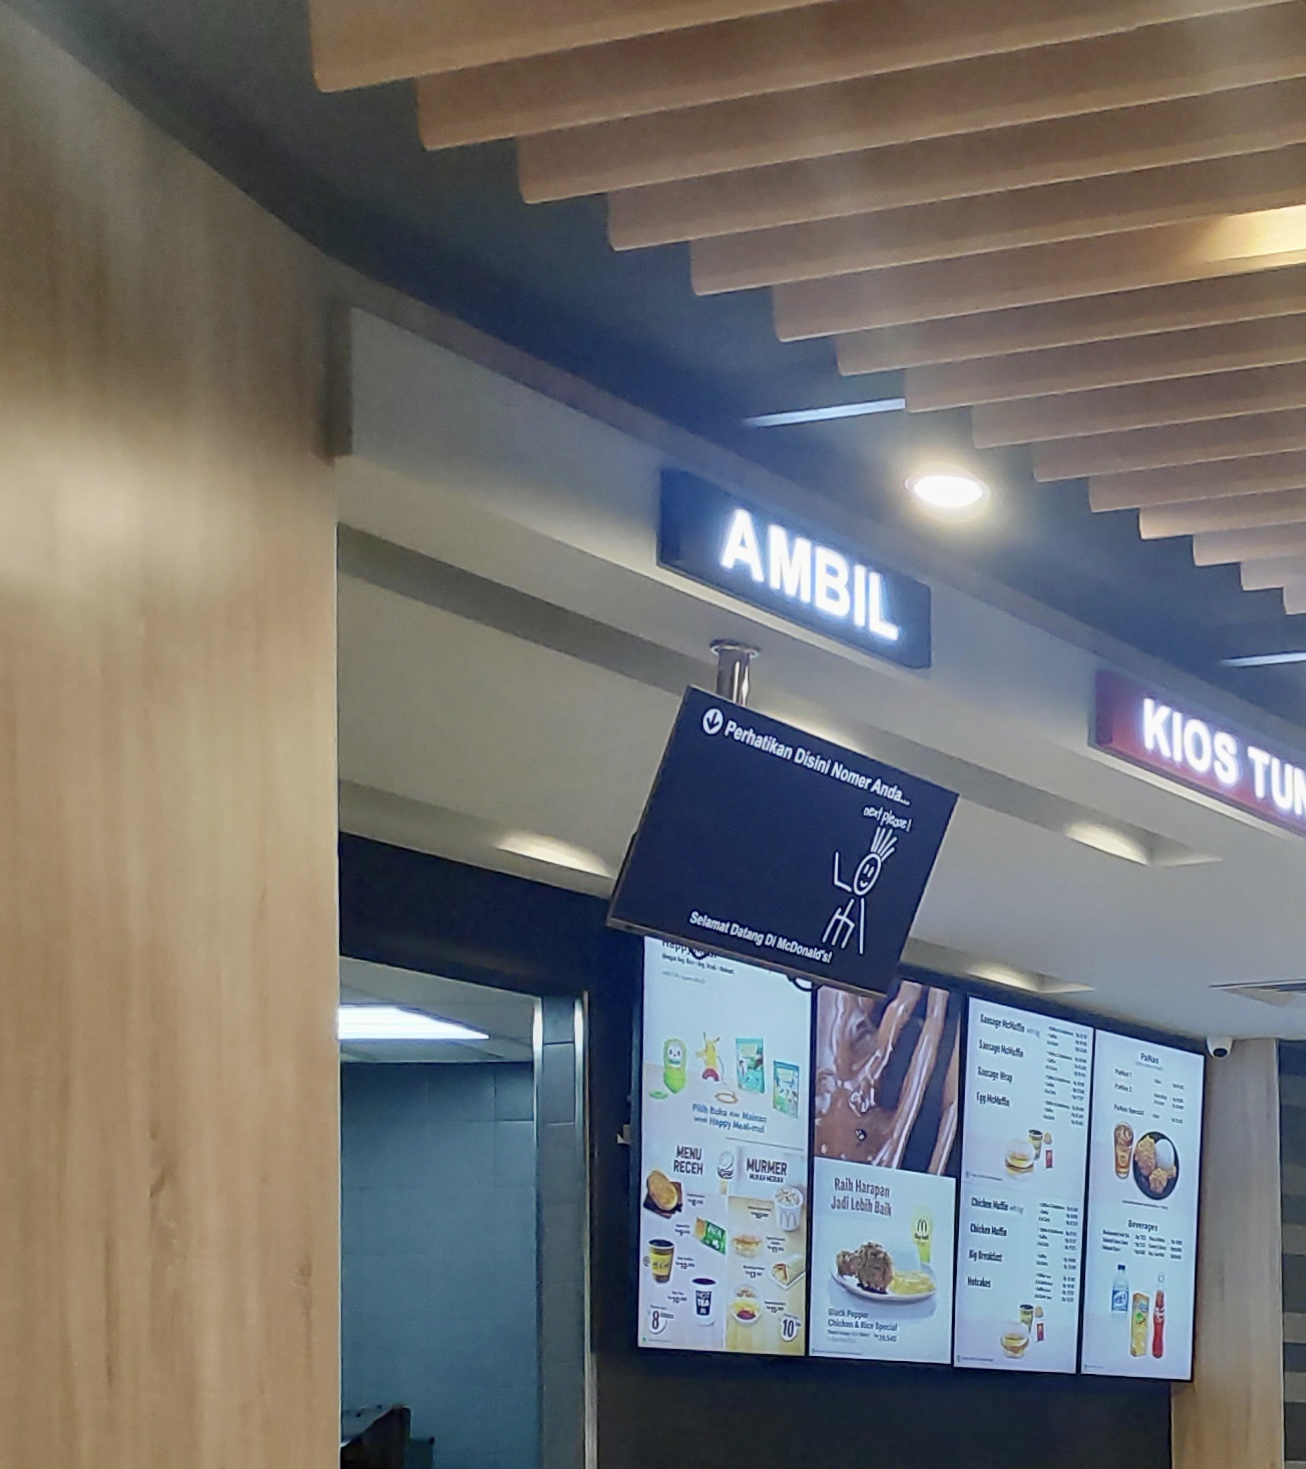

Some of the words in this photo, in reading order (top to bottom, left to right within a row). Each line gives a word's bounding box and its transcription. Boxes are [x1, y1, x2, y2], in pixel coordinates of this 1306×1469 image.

[720, 508, 899, 641] AMBIL
[1143, 698, 1239, 785] KIOS
[724, 720, 793, 760] Perhatikan
[794, 748, 831, 775] Disini
[830, 761, 873, 790] Nomer
[689, 911, 730, 934] Selamat
[730, 922, 765, 946] Datang
[764, 933, 776, 947] Di
[776, 937, 833, 964] McDonald's!
[676, 1145, 703, 1161] MENU
[673, 1159, 704, 1176] RECEH
[746, 1157, 788, 1176] MURMER
[834, 1177, 853, 1192] Raih
[855, 1179, 890, 1199] Harapan
[830, 1195, 849, 1211] Jadi
[851, 1198, 873, 1213] Lebih
[874, 1201, 892, 1217] Baik
[1128, 1219, 1158, 1232] Beverages
